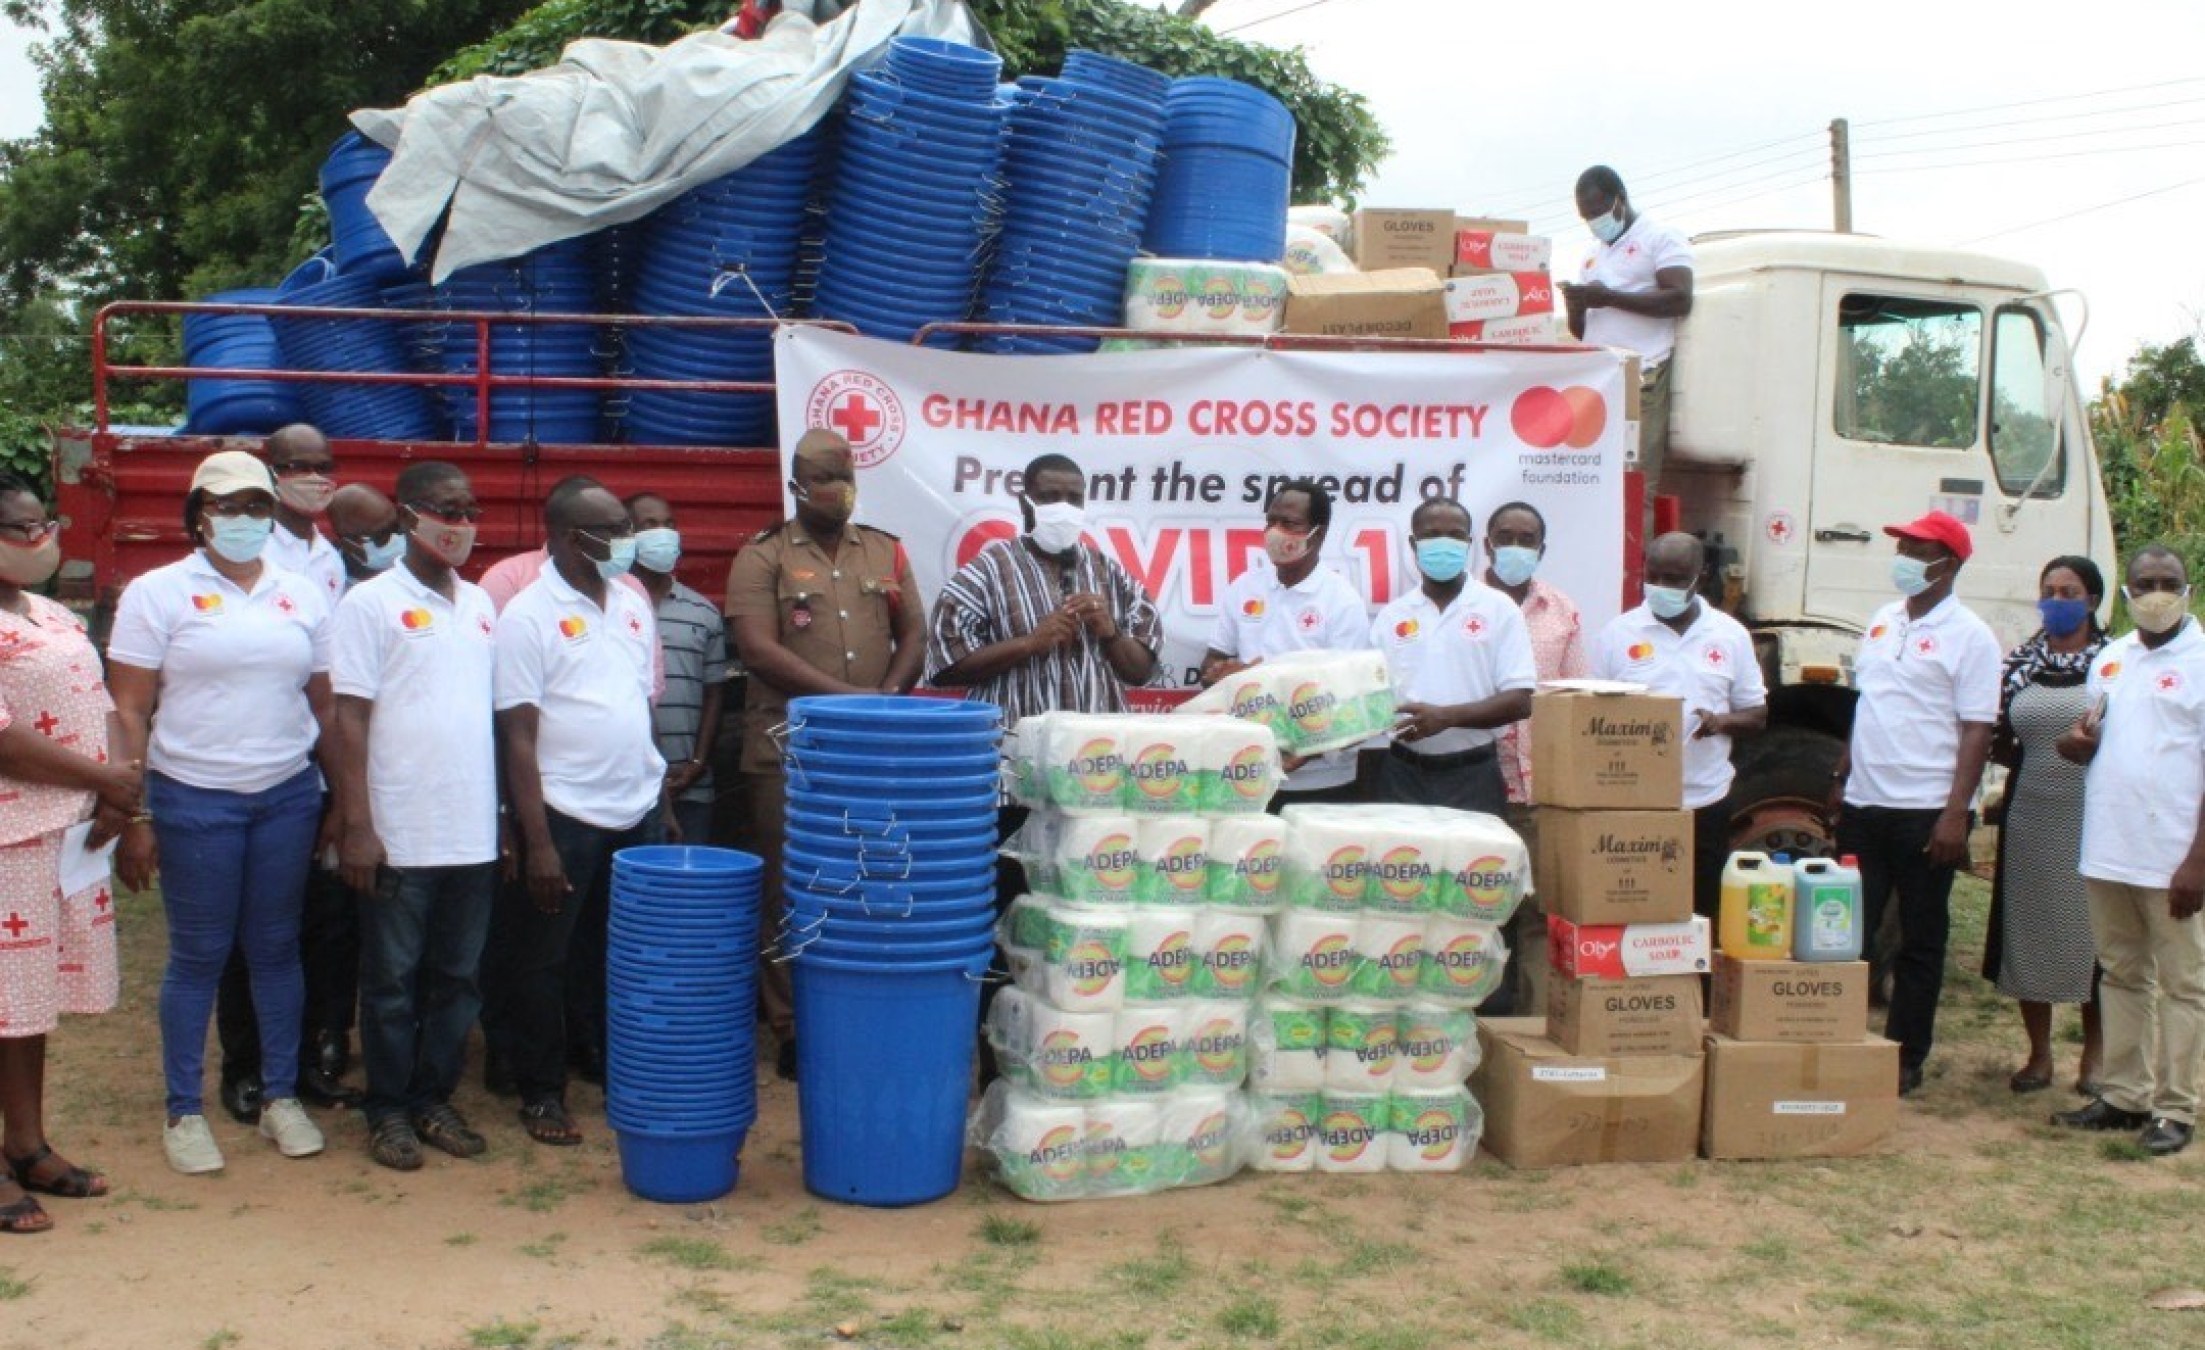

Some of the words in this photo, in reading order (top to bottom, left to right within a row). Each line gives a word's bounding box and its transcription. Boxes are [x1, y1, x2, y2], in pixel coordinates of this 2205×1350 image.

[1384, 220, 1434, 232] GLOVES
[922, 393, 1079, 434] GHANA
[1095, 401, 1173, 435] RED
[1188, 400, 1317, 436] CROSS
[1331, 402, 1488, 438] SOCIETY
[1518, 453, 1601, 467] mastercard
[953, 455, 1137, 501] Prent
[1151, 461, 1225, 501] the
[1242, 463, 1405, 513] spead
[1419, 463, 1466, 502] of
[1522, 469, 1600, 485] foundation
[1130, 758, 1188, 781] ADEPA
[1084, 849, 1140, 872] ADEPA
[1371, 861, 1431, 880] ADEPA
[1632, 935, 1696, 948] CARBOLIC
[1649, 950, 1681, 960] SOAP
[1773, 981, 1842, 997] GLOVES
[1605, 994, 1676, 1012] GLOVES
[1319, 1125, 1375, 1146] ADEPA
